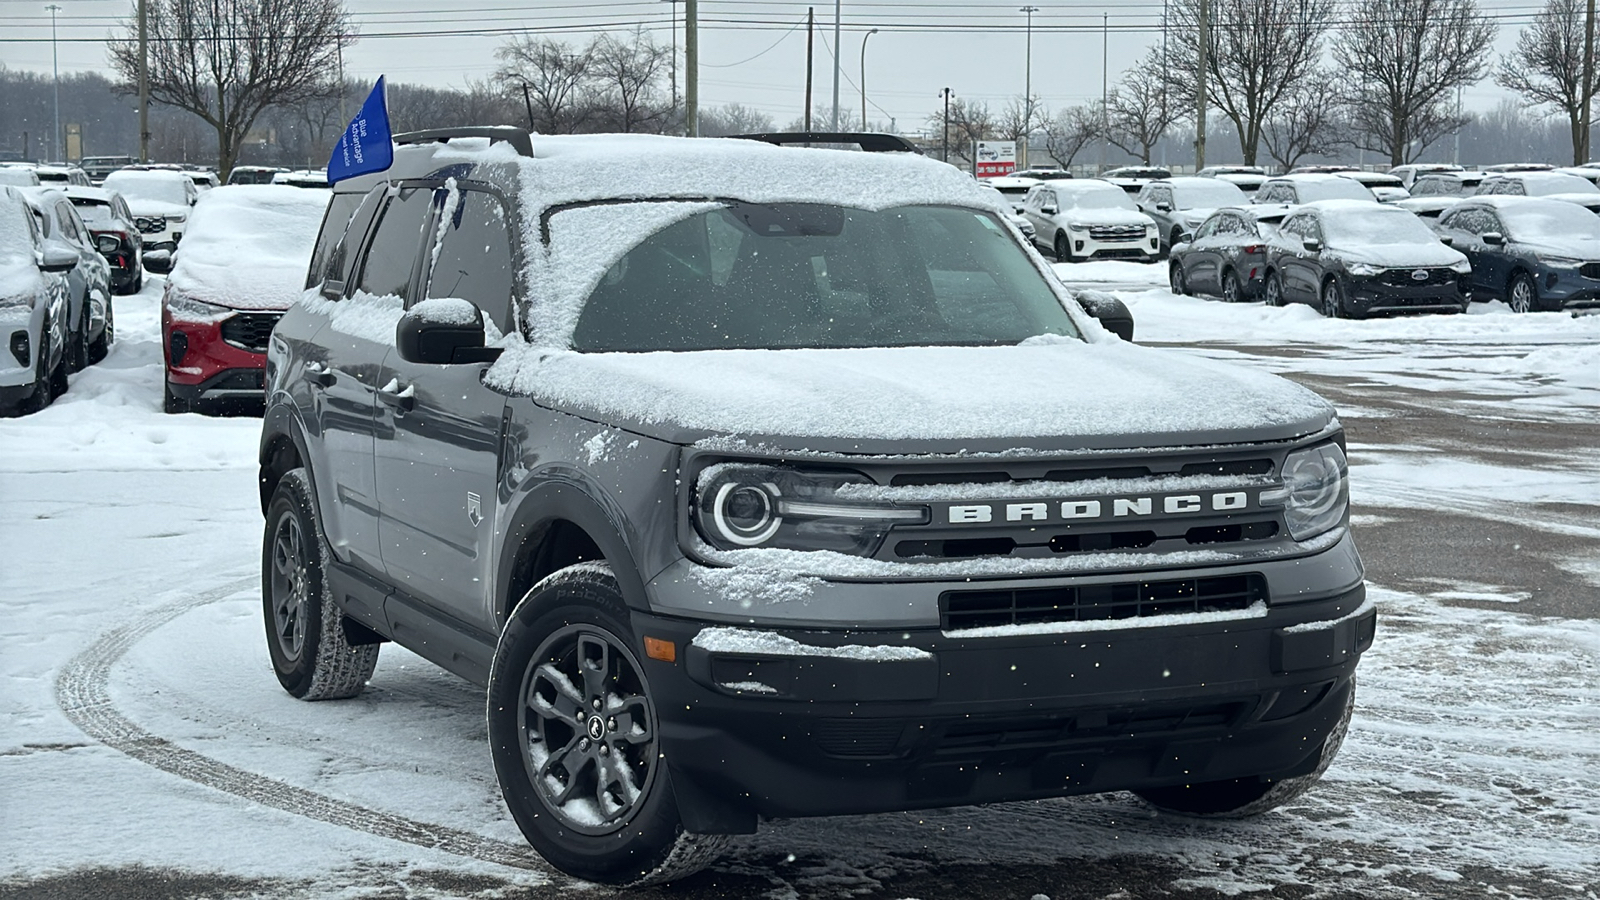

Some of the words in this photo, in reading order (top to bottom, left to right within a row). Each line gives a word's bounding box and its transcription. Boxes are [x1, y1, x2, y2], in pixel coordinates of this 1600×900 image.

[352, 124, 363, 164] Advantage
[358, 119, 367, 137] Blue
[948, 492, 1248, 524] BRONCO
